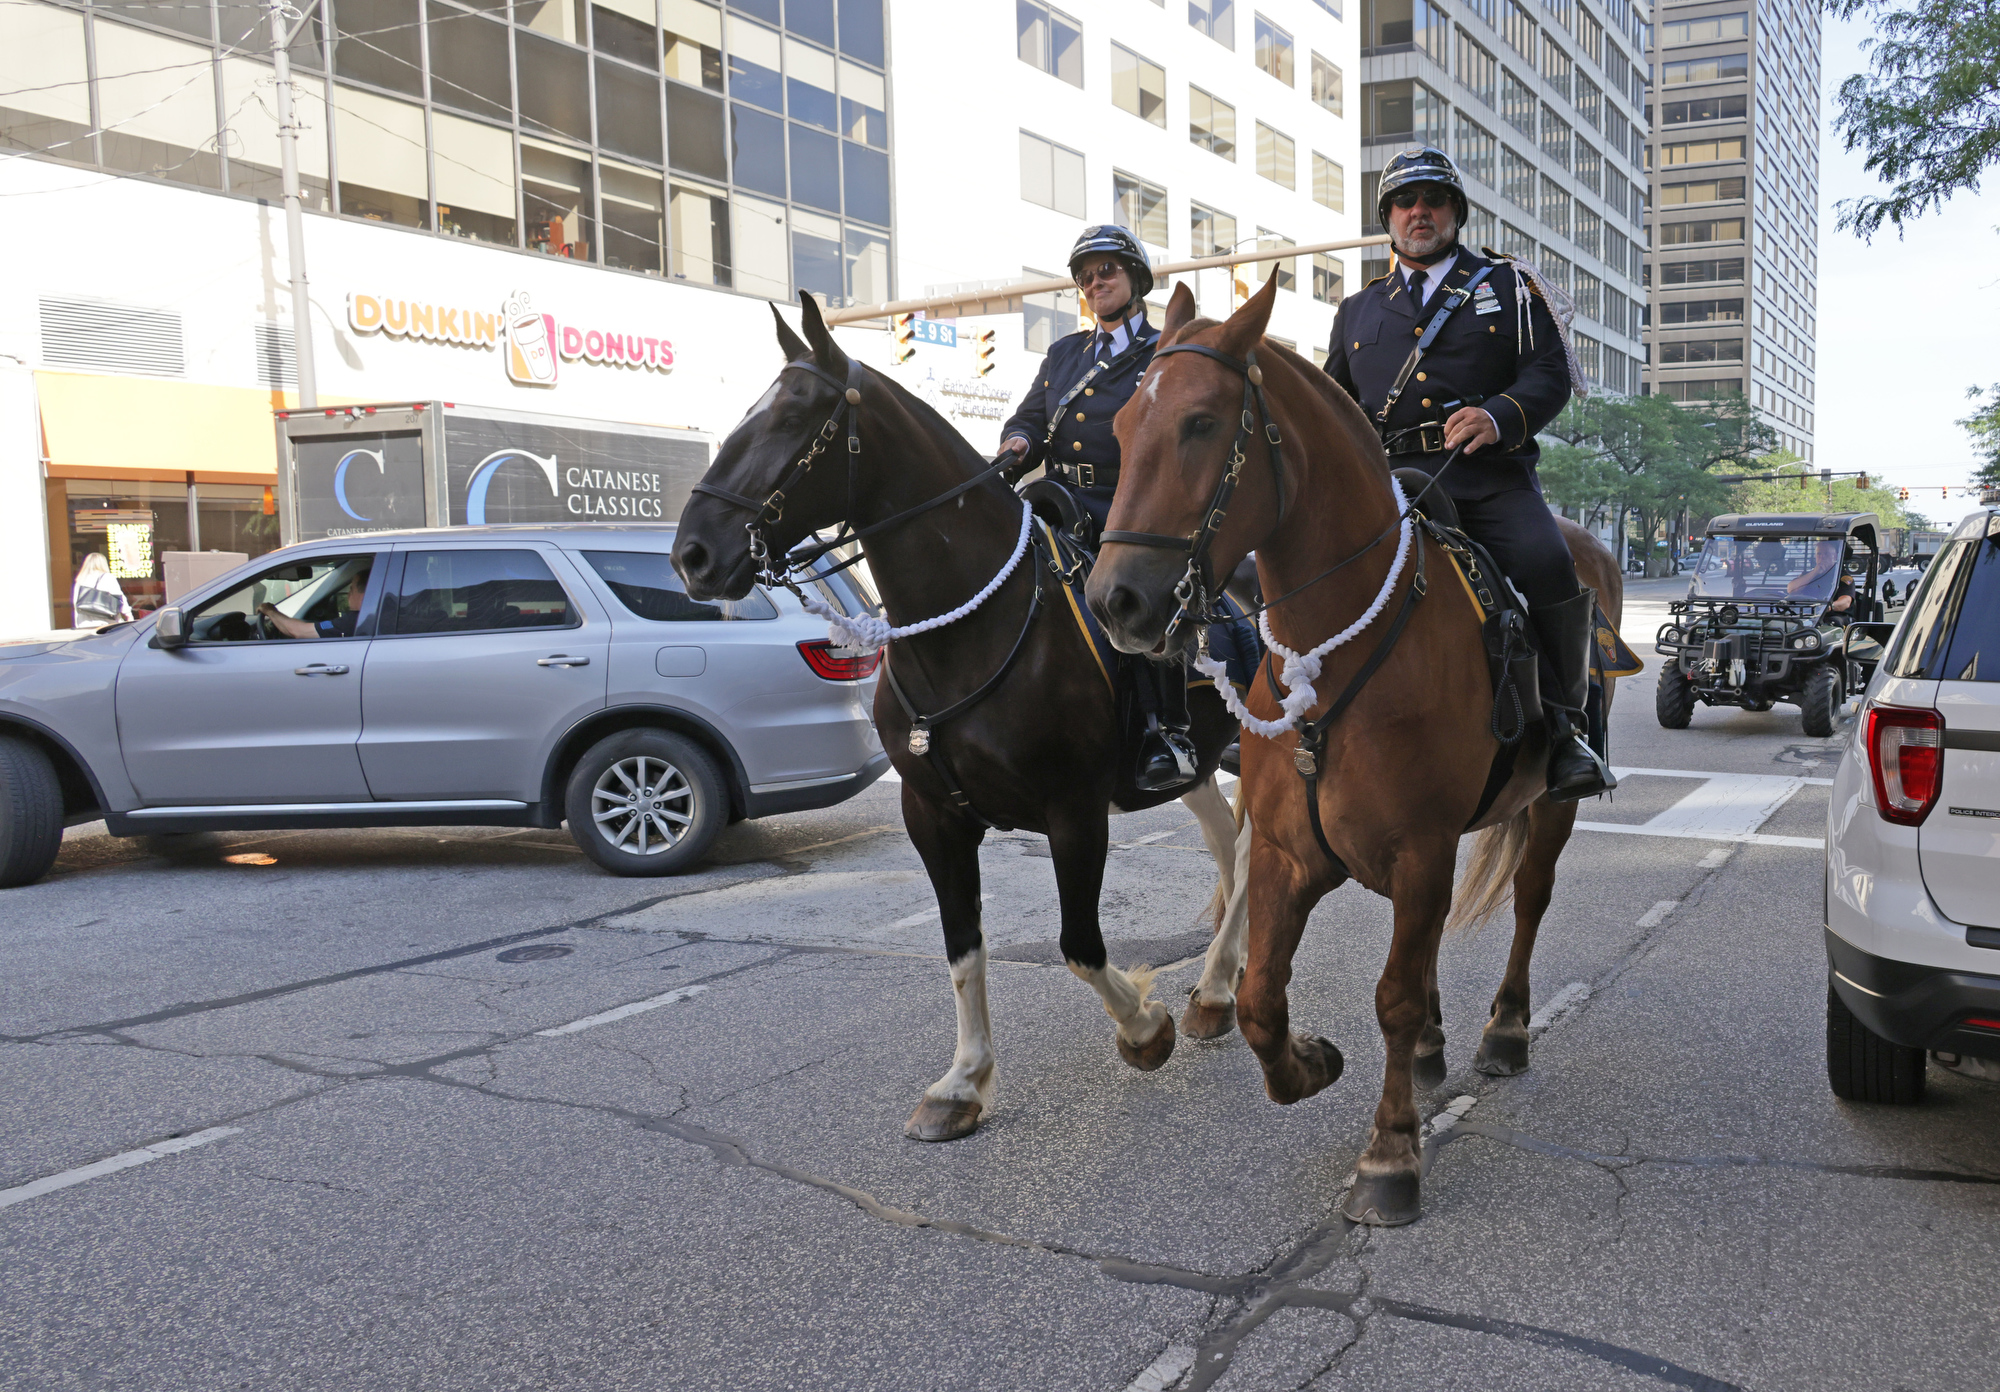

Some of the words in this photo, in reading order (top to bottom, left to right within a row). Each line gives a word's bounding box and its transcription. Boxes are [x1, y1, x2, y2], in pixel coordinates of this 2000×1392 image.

[914, 320, 925, 339] E.
[928, 323, 937, 341] 9
[940, 325, 953, 344] St
[563, 326, 674, 366] DONUTS
[942, 377, 979, 396] Catholic
[981, 383, 1012, 399] Diocese
[405, 414, 419, 424] 207
[962, 399, 1004, 417] Cleveland
[566, 467, 661, 493] CATANESE
[567, 494, 662, 518] CLASSICS
